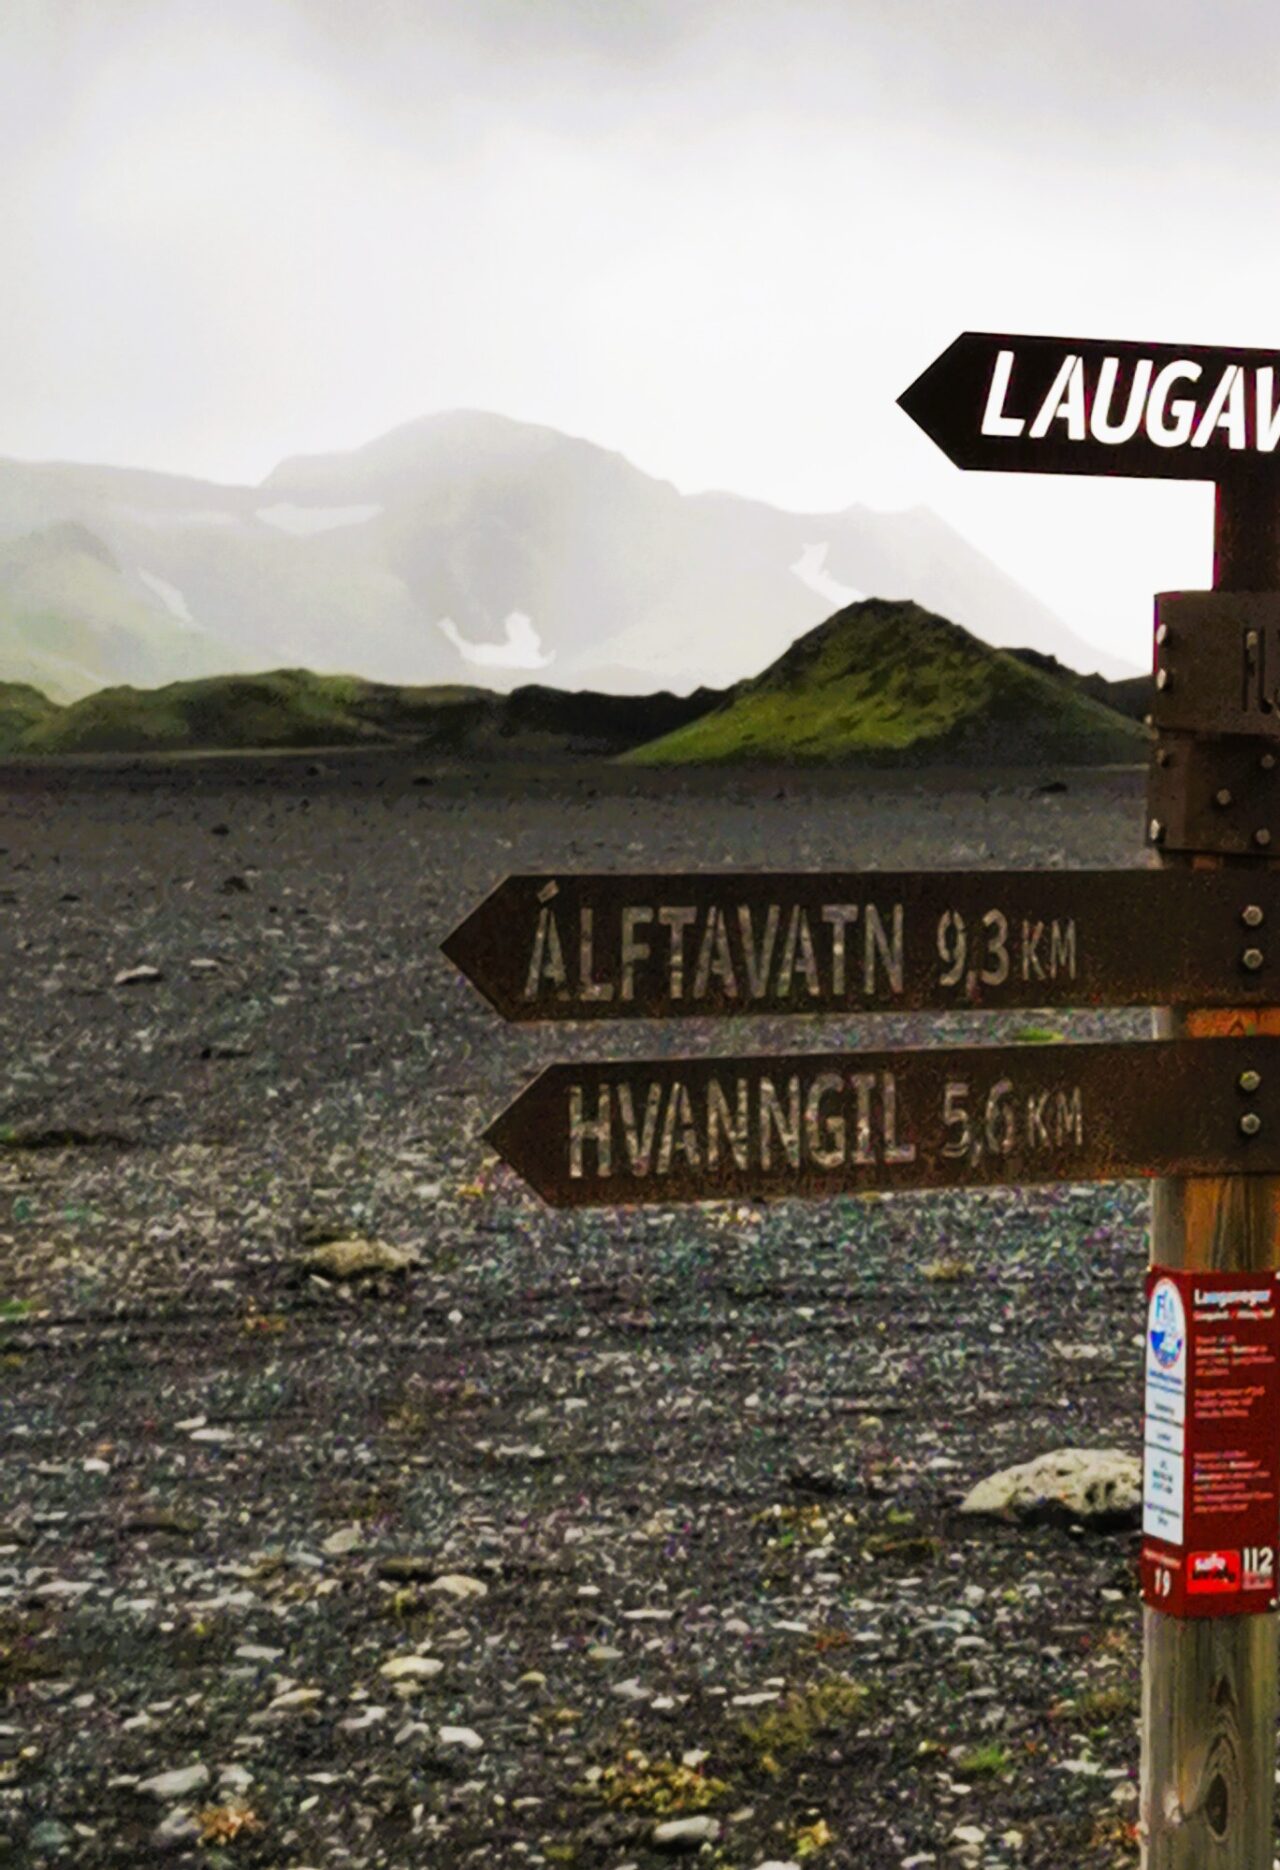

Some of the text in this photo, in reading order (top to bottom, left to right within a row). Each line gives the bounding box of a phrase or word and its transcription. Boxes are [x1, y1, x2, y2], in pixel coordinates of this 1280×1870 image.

[525, 879, 1076, 1001] ÁLFTAVATN 9,3 KM
[568, 1072, 1083, 1178] HVANNGIL 5,6 KM
[1243, 1546, 1274, 1576] 112
